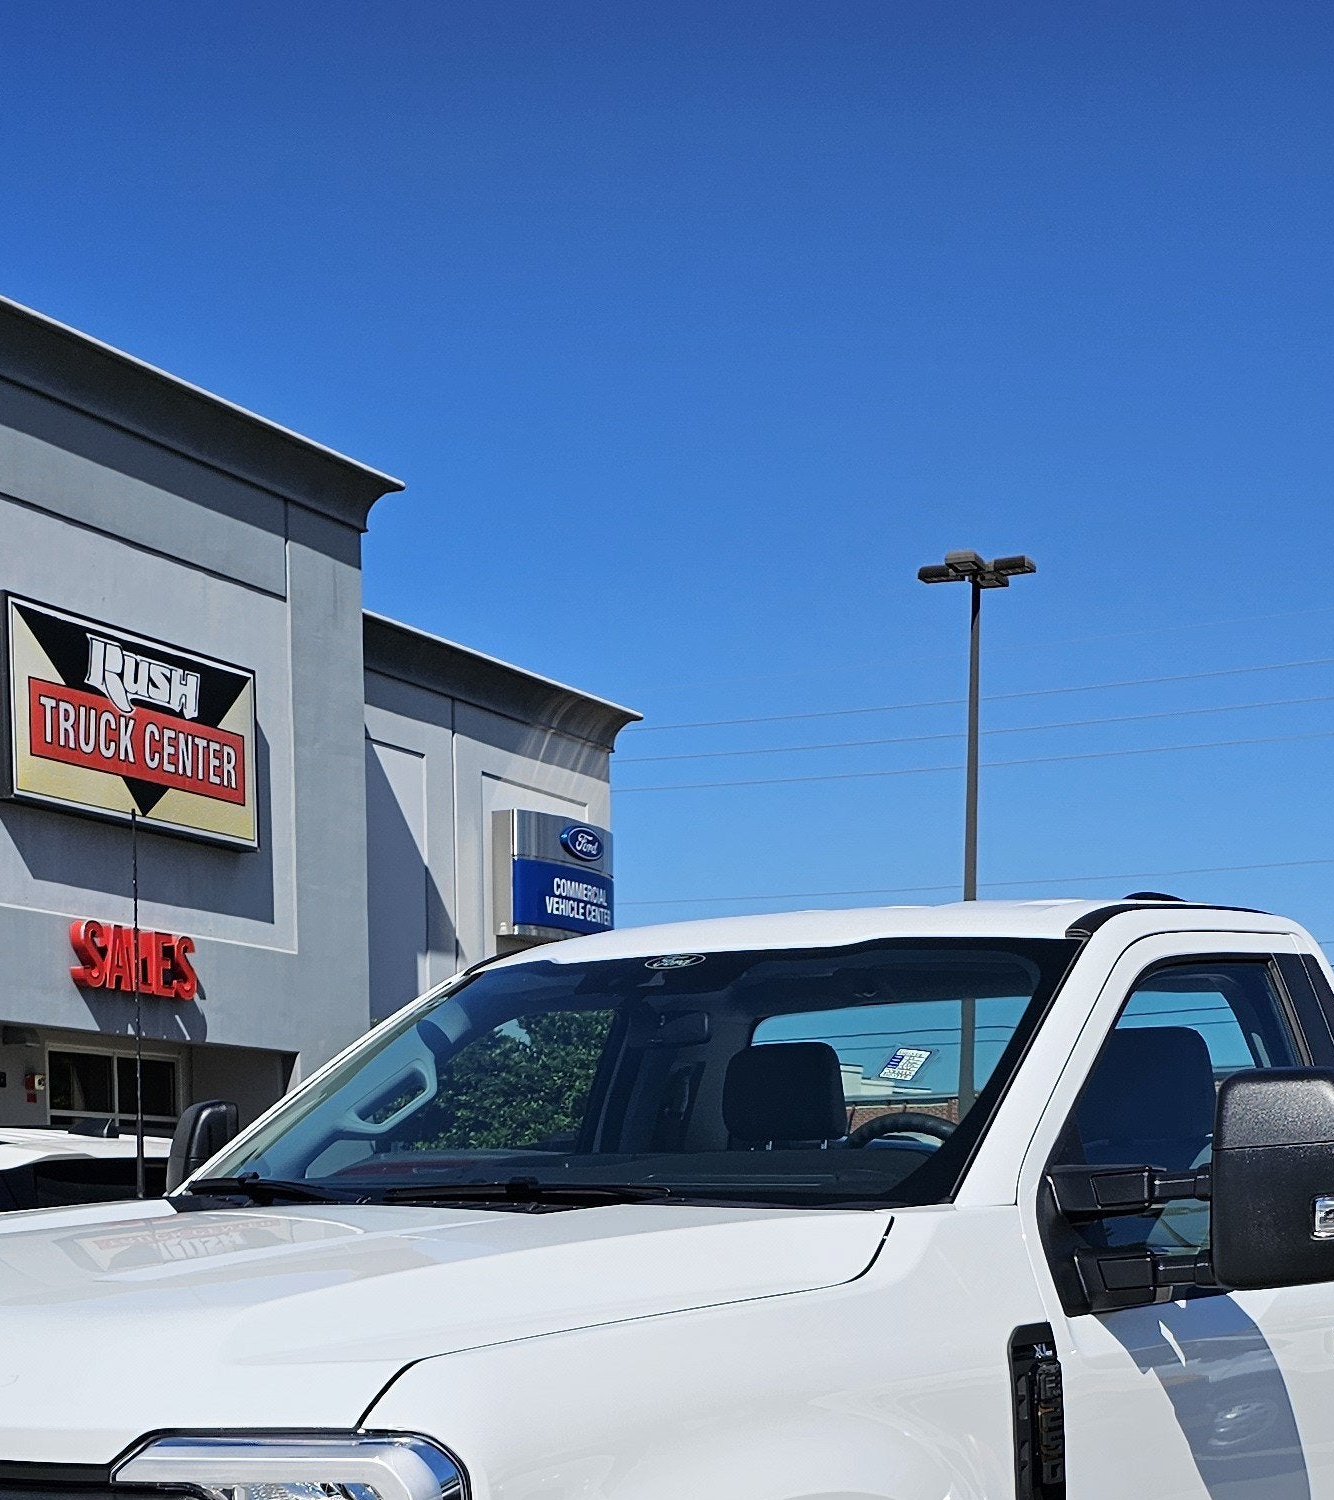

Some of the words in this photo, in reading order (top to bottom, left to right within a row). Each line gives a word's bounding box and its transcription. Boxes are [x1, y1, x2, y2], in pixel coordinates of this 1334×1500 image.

[84, 633, 201, 719] RUSH
[39, 694, 137, 764] TRUCK
[144, 722, 238, 790] CENTER
[575, 833, 598, 854] Ford
[553, 878, 607, 906] COMMERCIAL
[545, 896, 585, 920] VEHICLE
[586, 904, 612, 927] CENTER
[69, 920, 197, 1000] SALES
[1033, 1343, 1053, 1359] XL
